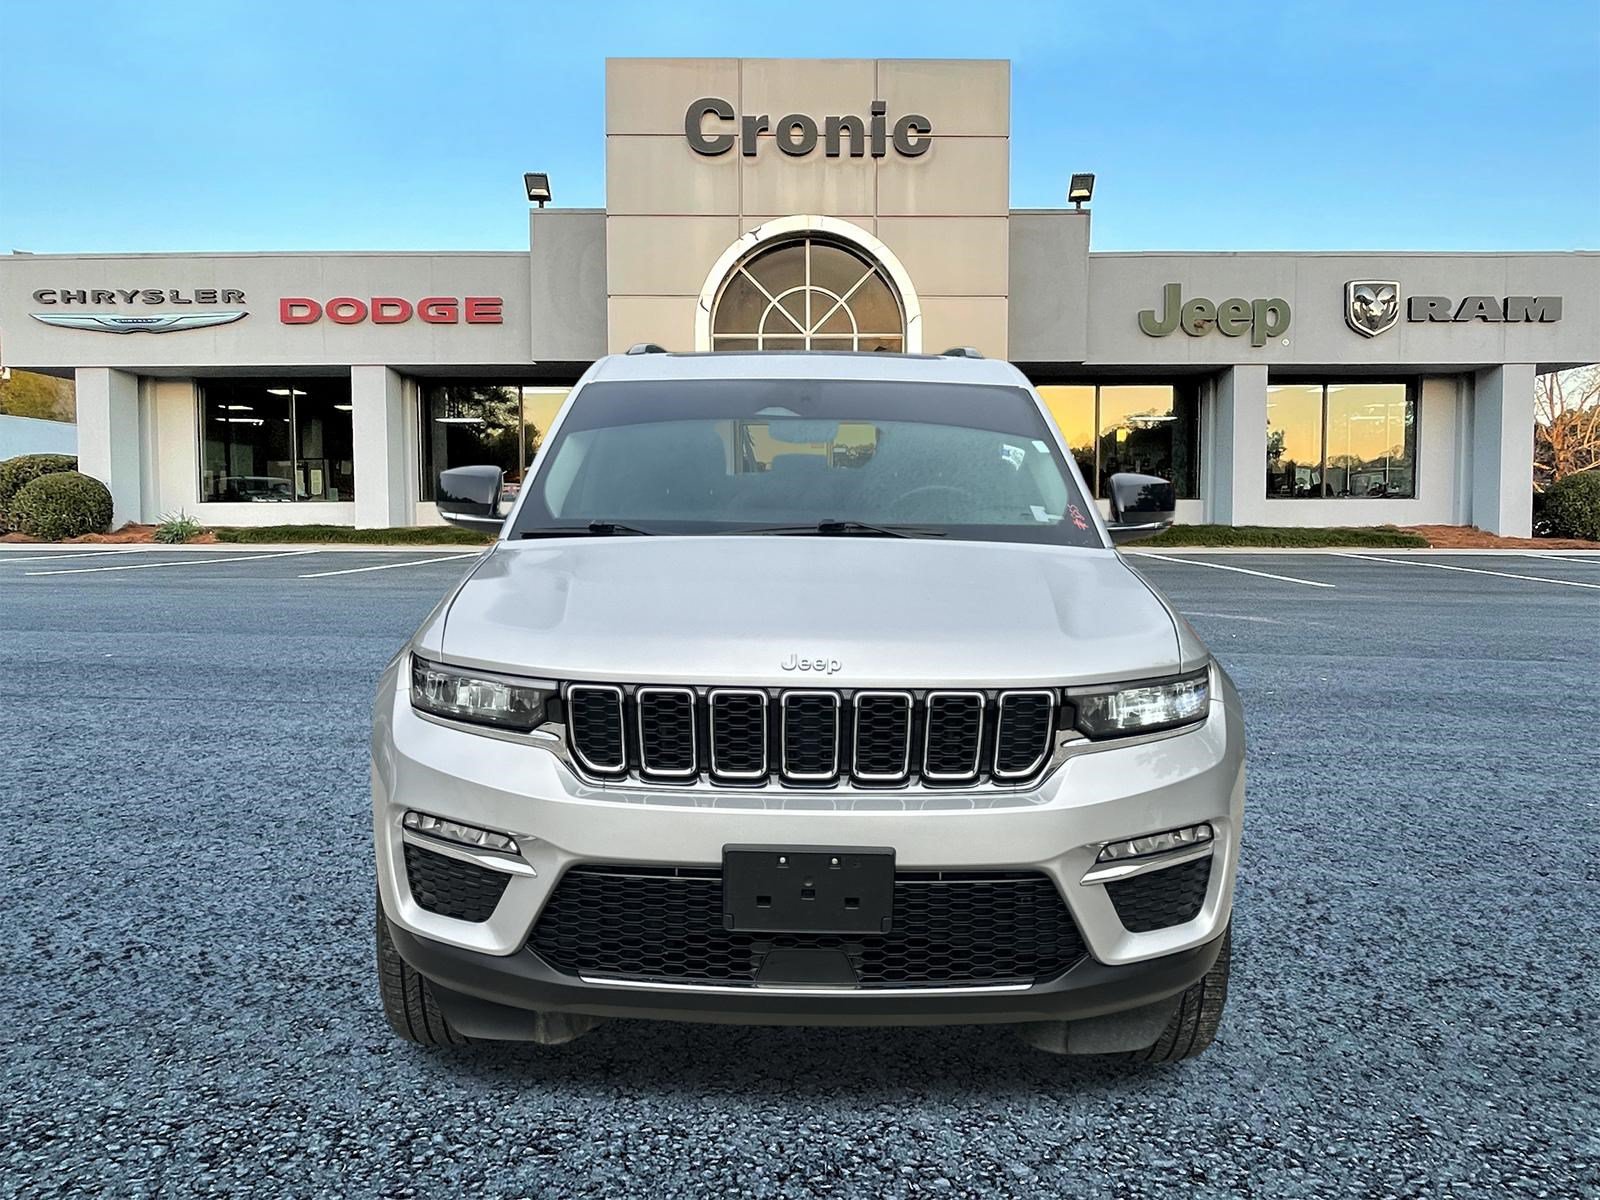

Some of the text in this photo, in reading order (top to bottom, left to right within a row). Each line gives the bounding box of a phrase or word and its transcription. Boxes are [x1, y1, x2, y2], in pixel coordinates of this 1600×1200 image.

[684, 97, 932, 157] Cronic
[32, 289, 246, 304] CHRYSLER
[1407, 296, 1562, 322] RAM
[280, 297, 503, 324] DODGE
[1138, 283, 1291, 347] Jeep
[781, 653, 842, 675] Jeep
